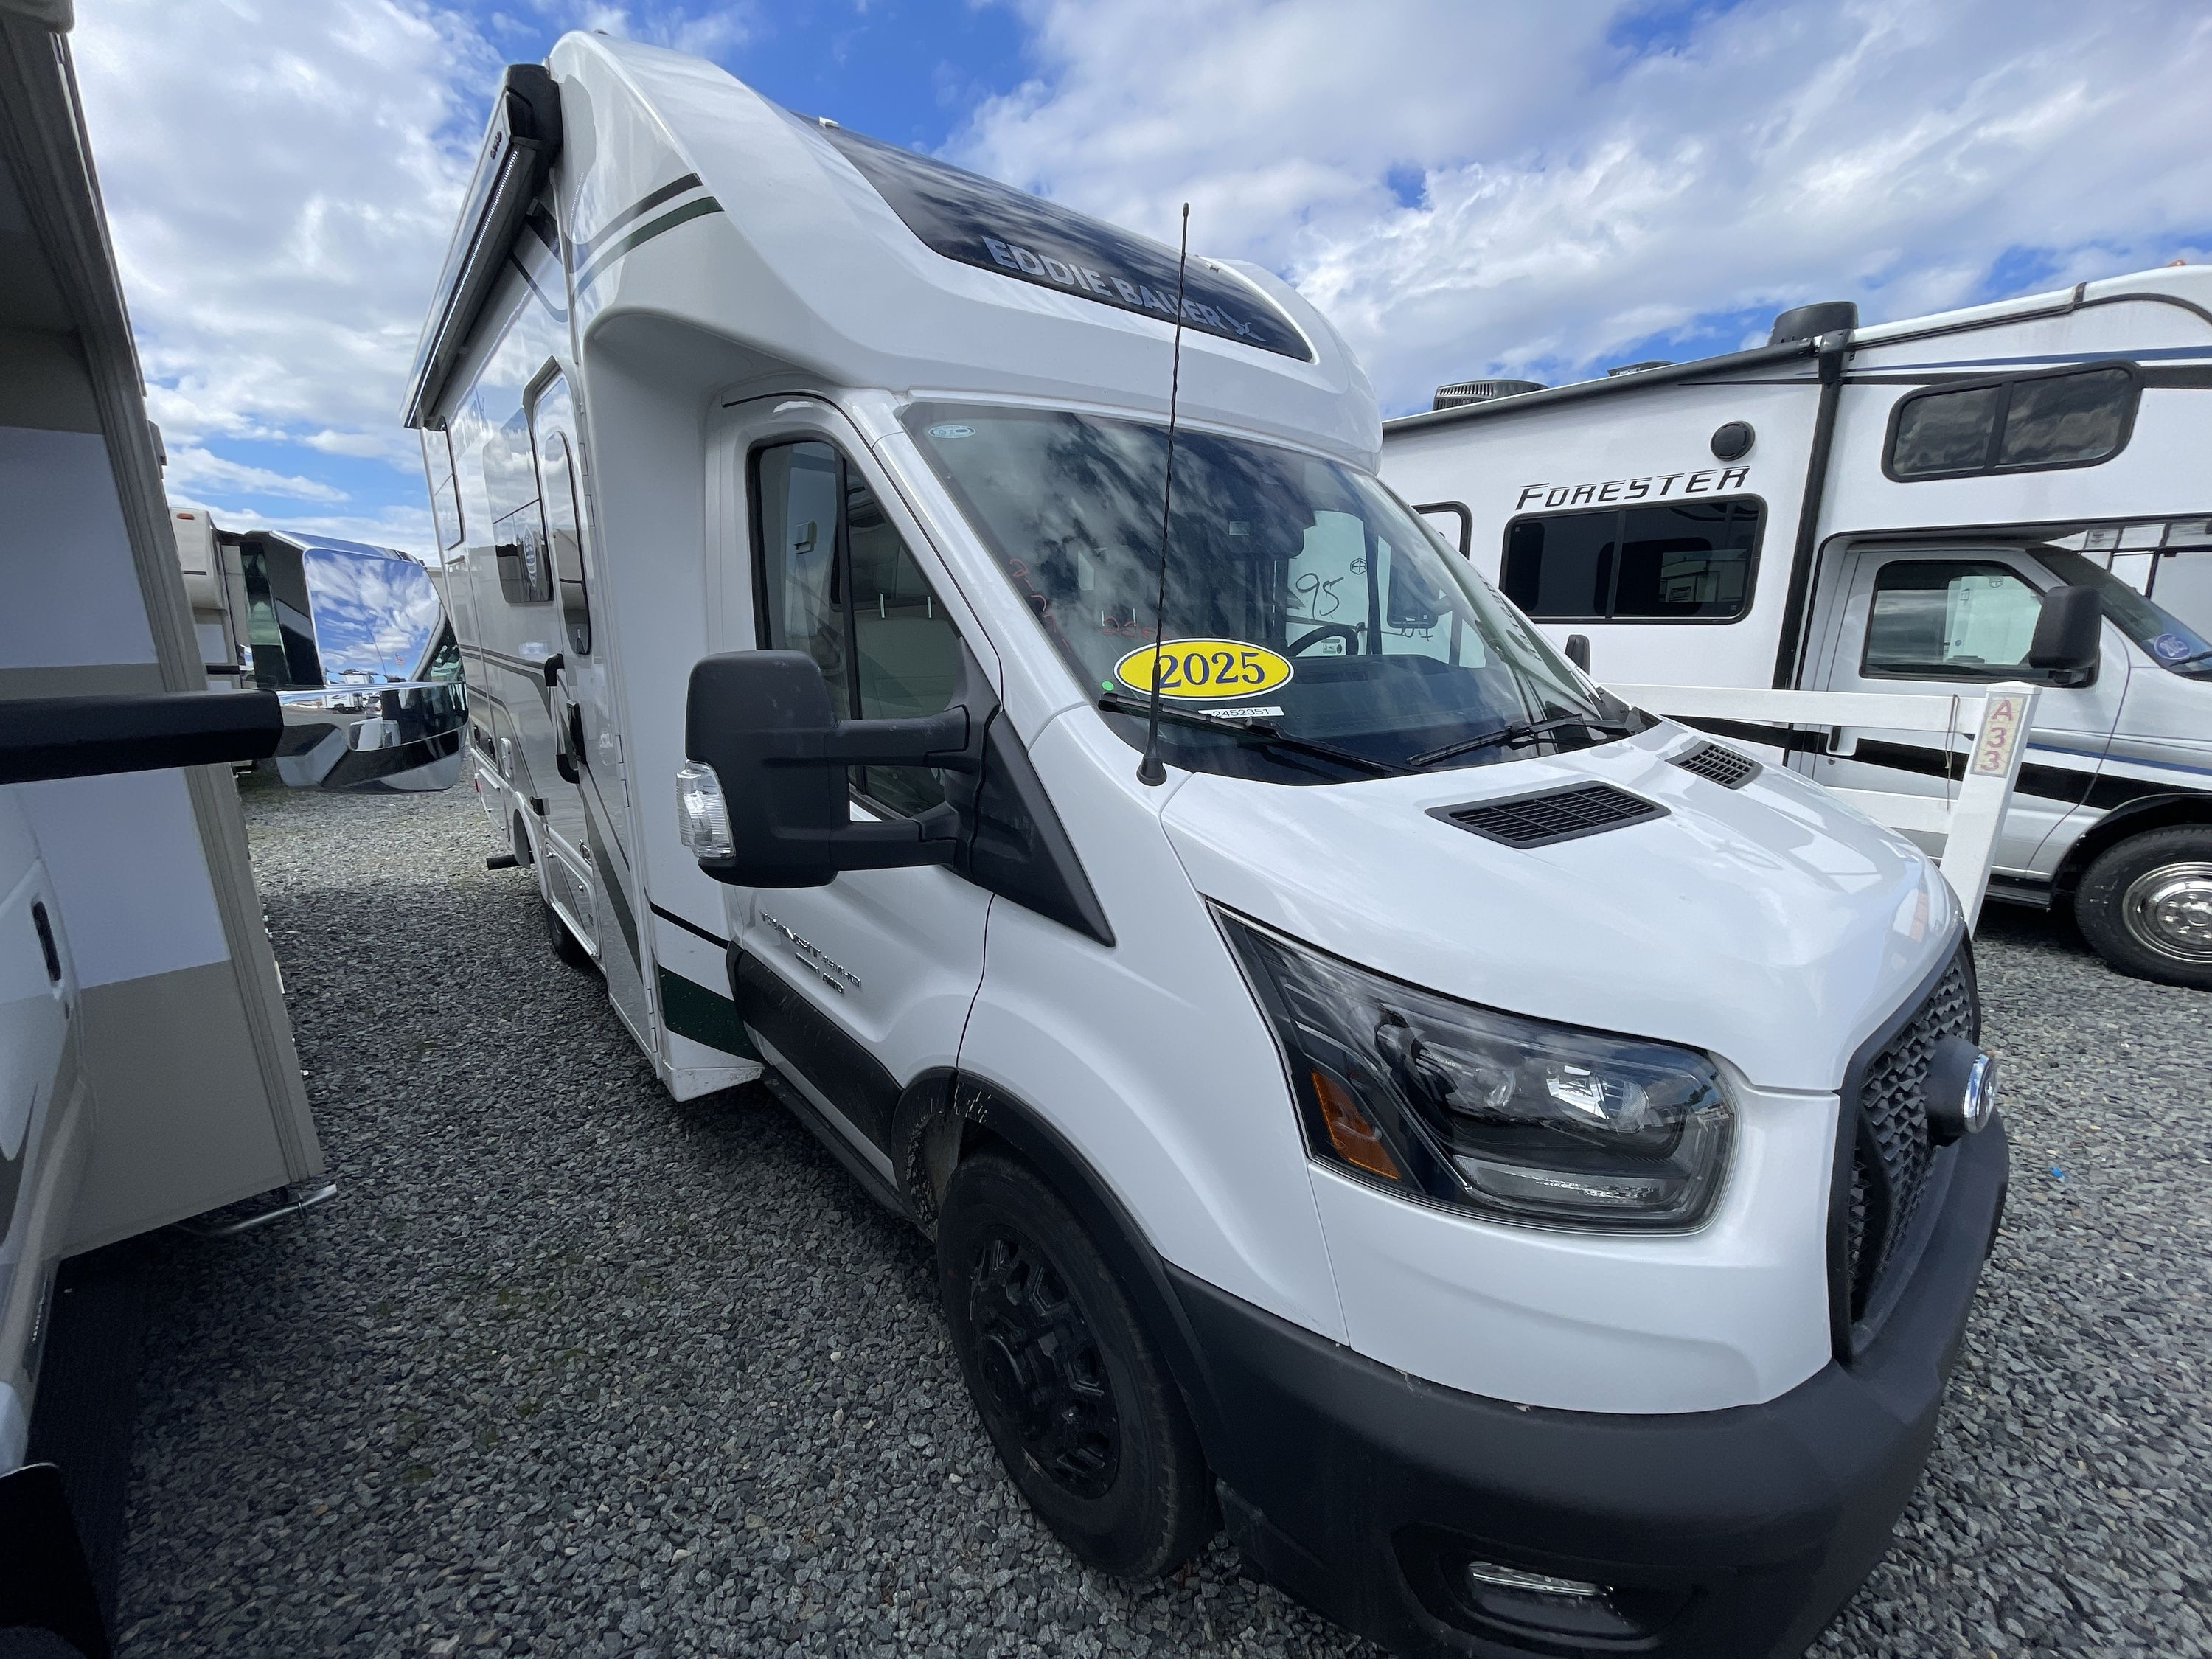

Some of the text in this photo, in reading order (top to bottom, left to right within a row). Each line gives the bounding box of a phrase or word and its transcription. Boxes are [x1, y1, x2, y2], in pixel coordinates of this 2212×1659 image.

[981, 235, 1227, 330] EDDIE BAUER
[1515, 465, 1751, 511] FORESTER
[1158, 651, 1266, 689] 2025
[1212, 708, 1270, 718] 2452351
